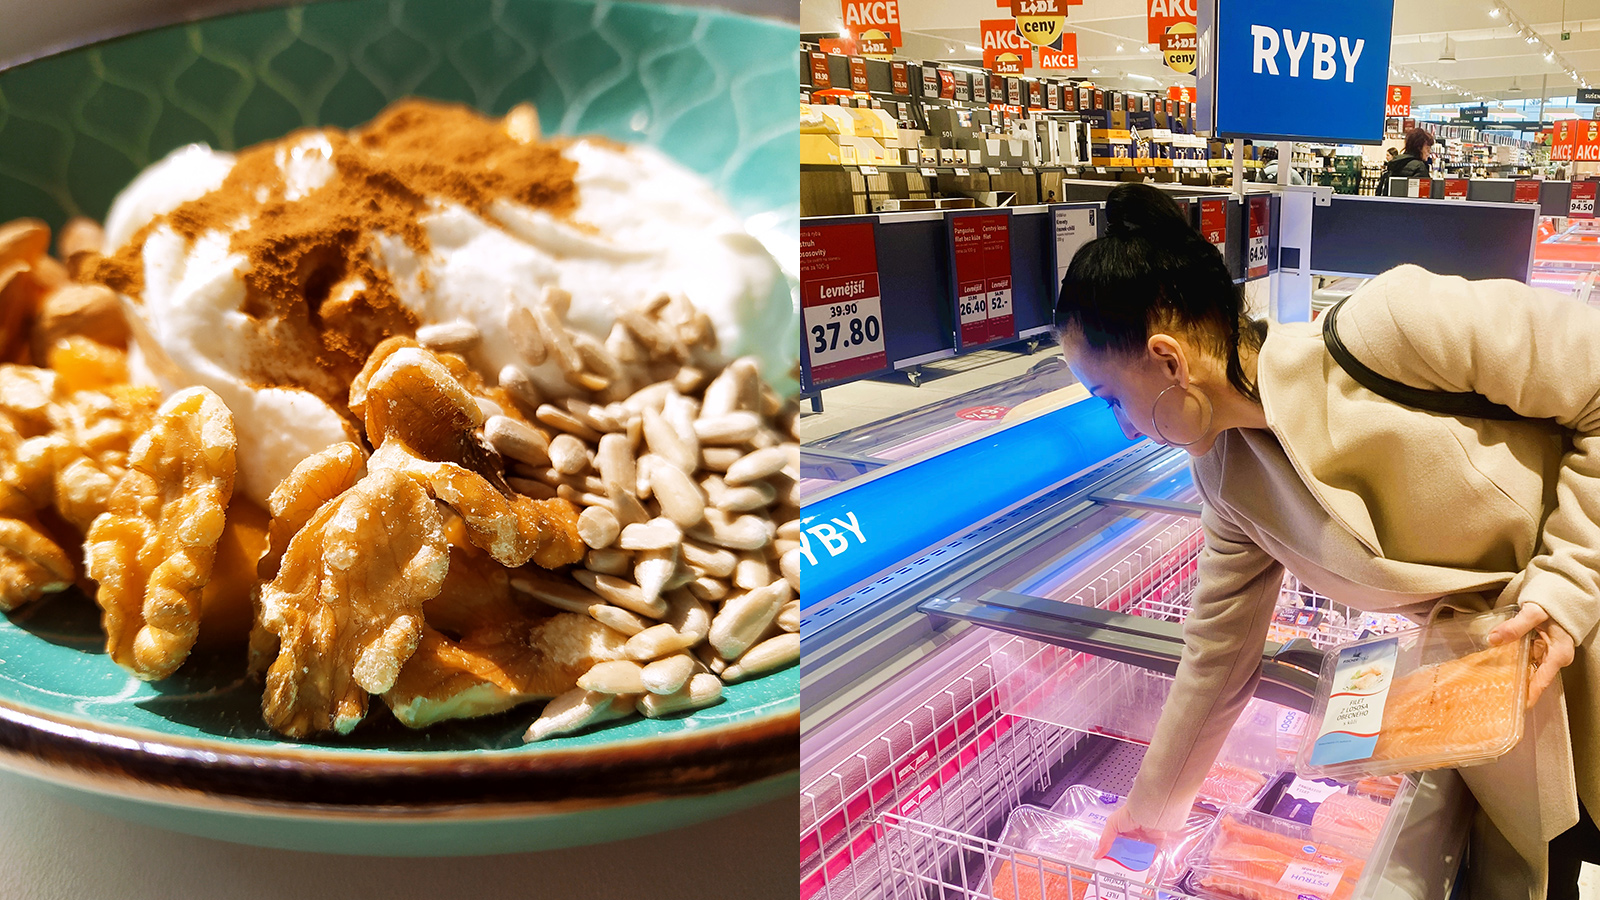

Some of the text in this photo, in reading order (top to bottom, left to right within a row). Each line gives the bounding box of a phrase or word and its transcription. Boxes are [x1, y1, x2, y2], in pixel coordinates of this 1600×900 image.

[846, 1, 898, 26] AKCE
[1024, 21, 1056, 35] ceny
[984, 30, 1030, 50] AKCE
[1043, 54, 1075, 68] AKCE
[1170, 54, 1195, 65] ceny
[1250, 24, 1366, 83] RYBY
[1387, 104, 1409, 116] AKCE
[1552, 144, 1573, 160] AKCE
[1576, 144, 1600, 160] AKC
[1571, 203, 1593, 211] 94.50
[1249, 245, 1268, 263] 64.90
[820, 279, 865, 299] Levnější!
[830, 303, 858, 318] 39.90
[960, 300, 986, 316] 26.40
[991, 297, 1008, 310] 52.-
[811, 315, 880, 354] 37.80
[800, 511, 867, 572] YBY
[1346, 703, 1369, 713] LOSOSA
[1349, 697, 1365, 706] FILET
[1278, 711, 1297, 732] LOSOS
[1290, 873, 1330, 888] PSTRUH
